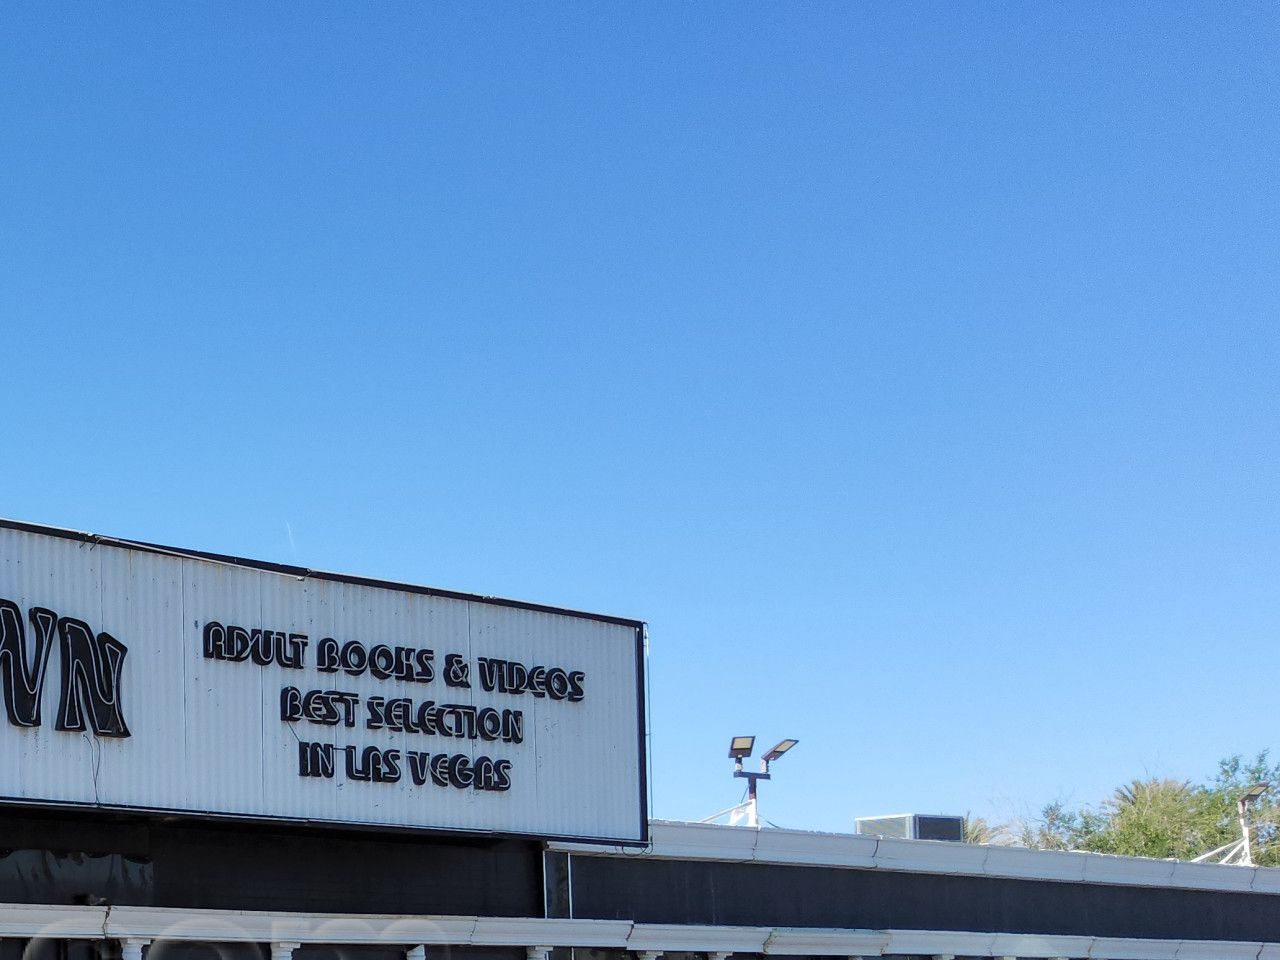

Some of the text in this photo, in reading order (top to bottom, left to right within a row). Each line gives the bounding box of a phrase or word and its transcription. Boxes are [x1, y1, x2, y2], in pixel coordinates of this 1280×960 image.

[203, 621, 585, 702] ADULT BOOKS & VIDEOS
[281, 686, 523, 743] BEST SELECTION
[299, 741, 512, 791] IN LAS VEGAS
